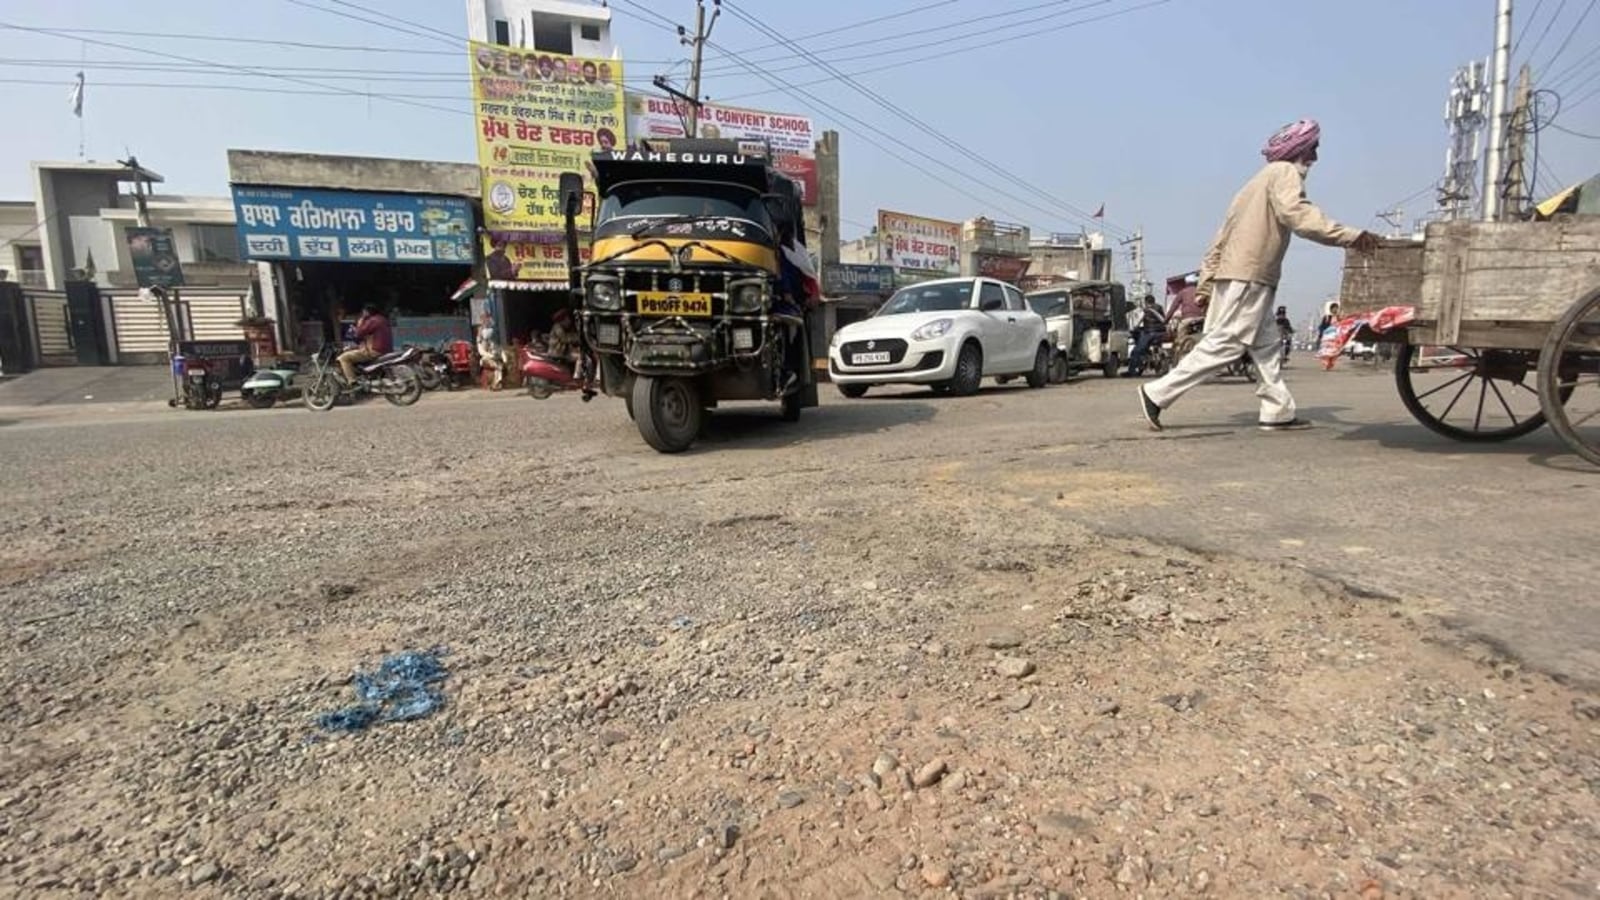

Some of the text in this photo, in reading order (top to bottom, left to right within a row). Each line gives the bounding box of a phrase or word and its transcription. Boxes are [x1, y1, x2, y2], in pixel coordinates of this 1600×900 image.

[547, 107, 565, 121] ਸਿੰਘ
[648, 99, 712, 121] BLOSSMS
[716, 110, 767, 127] CONVENT
[769, 115, 812, 133] SCHOOL
[481, 115, 595, 147] ਮੁੱਖ ਚੋਣ ਦਫਤਰ
[610, 151, 745, 165] WAHEGURU
[517, 183, 537, 199] ਚੋਣ
[240, 199, 415, 232] ਬਾਬਾ ਕਰਿਆਨਾ ਭੰਡਾਰ
[641, 298, 707, 313] PB10FF 9474
